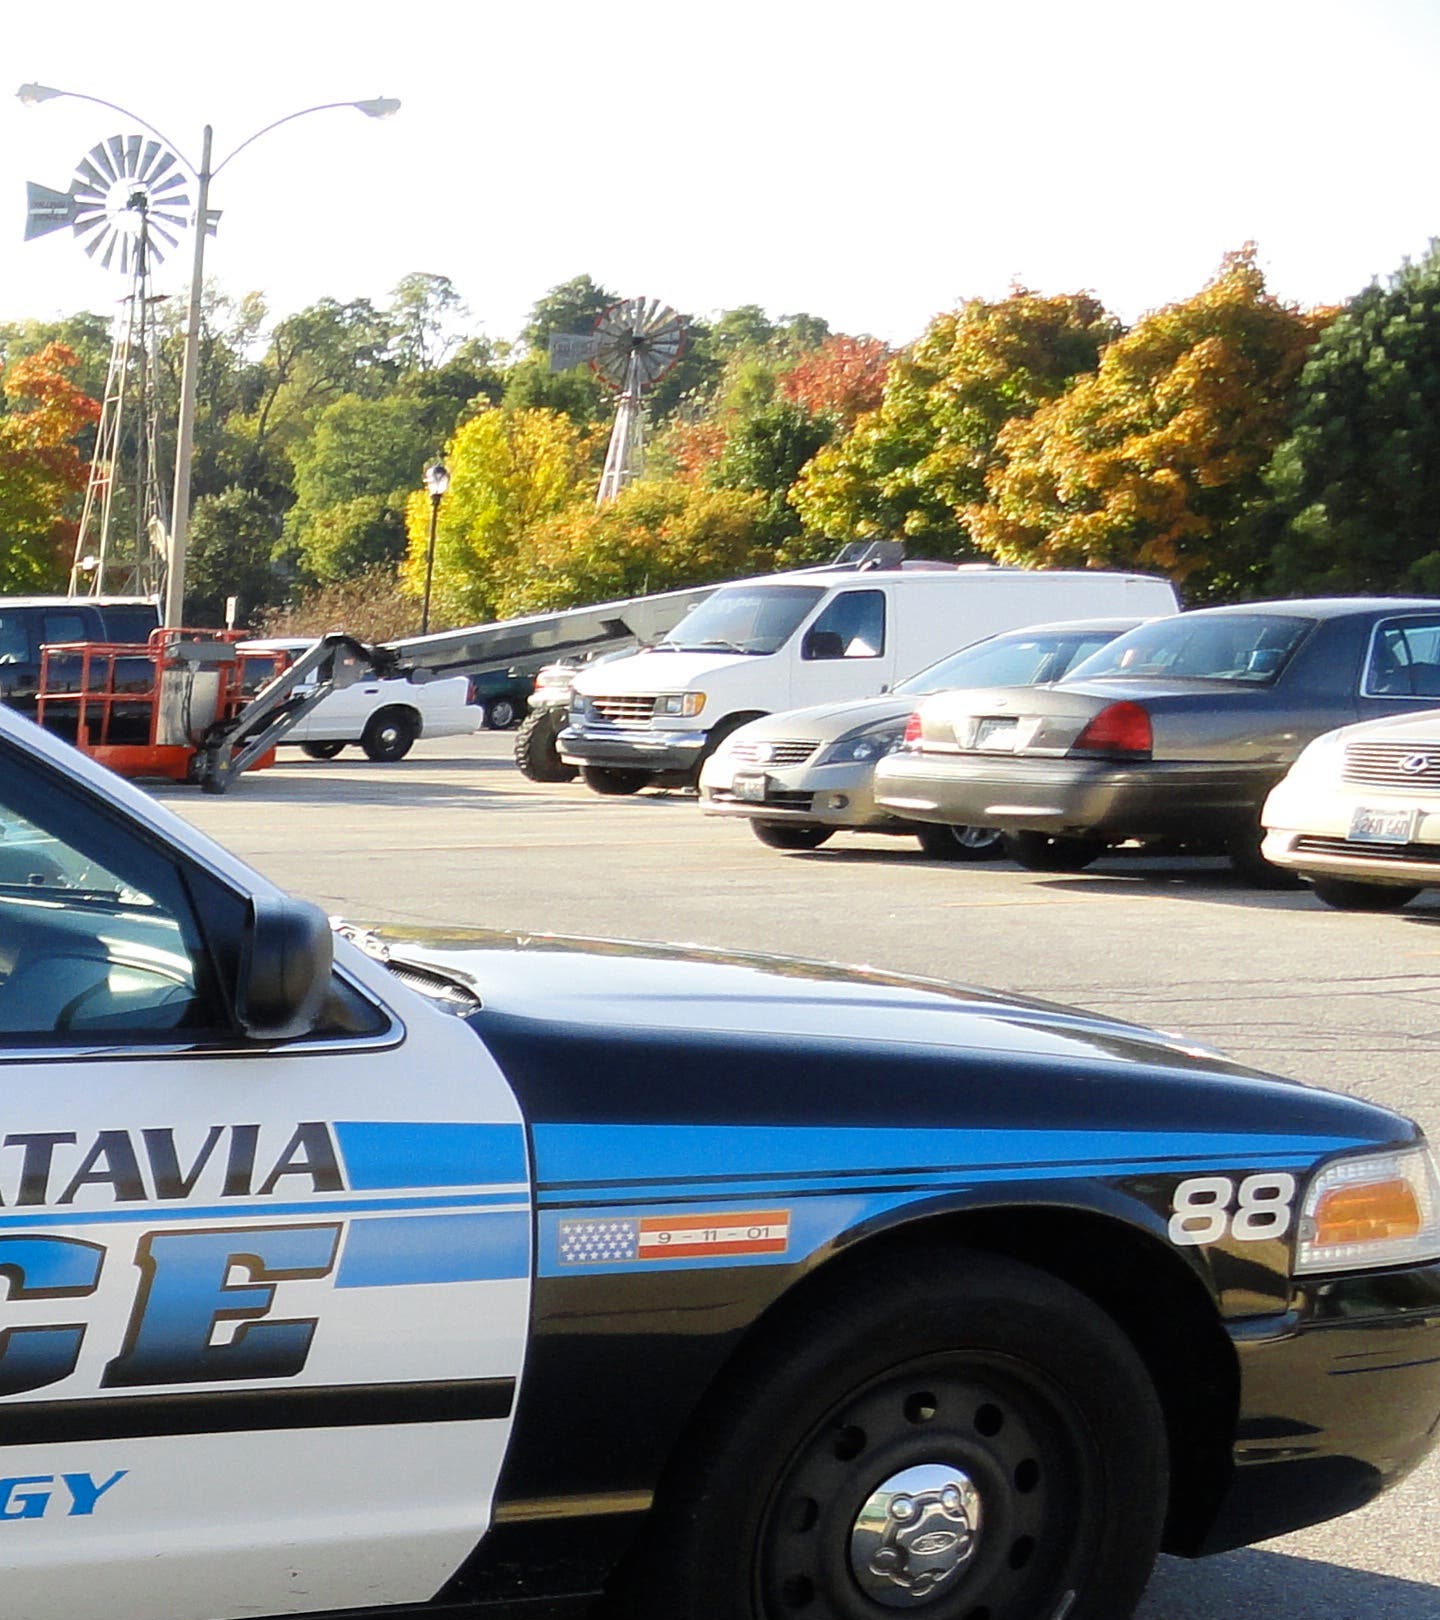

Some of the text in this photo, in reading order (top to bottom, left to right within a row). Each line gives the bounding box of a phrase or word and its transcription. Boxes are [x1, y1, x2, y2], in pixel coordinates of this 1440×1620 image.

[1167, 1172, 1296, 1246] 88
[702, 1229, 717, 1242] 11
[747, 1227, 770, 1240] 01
